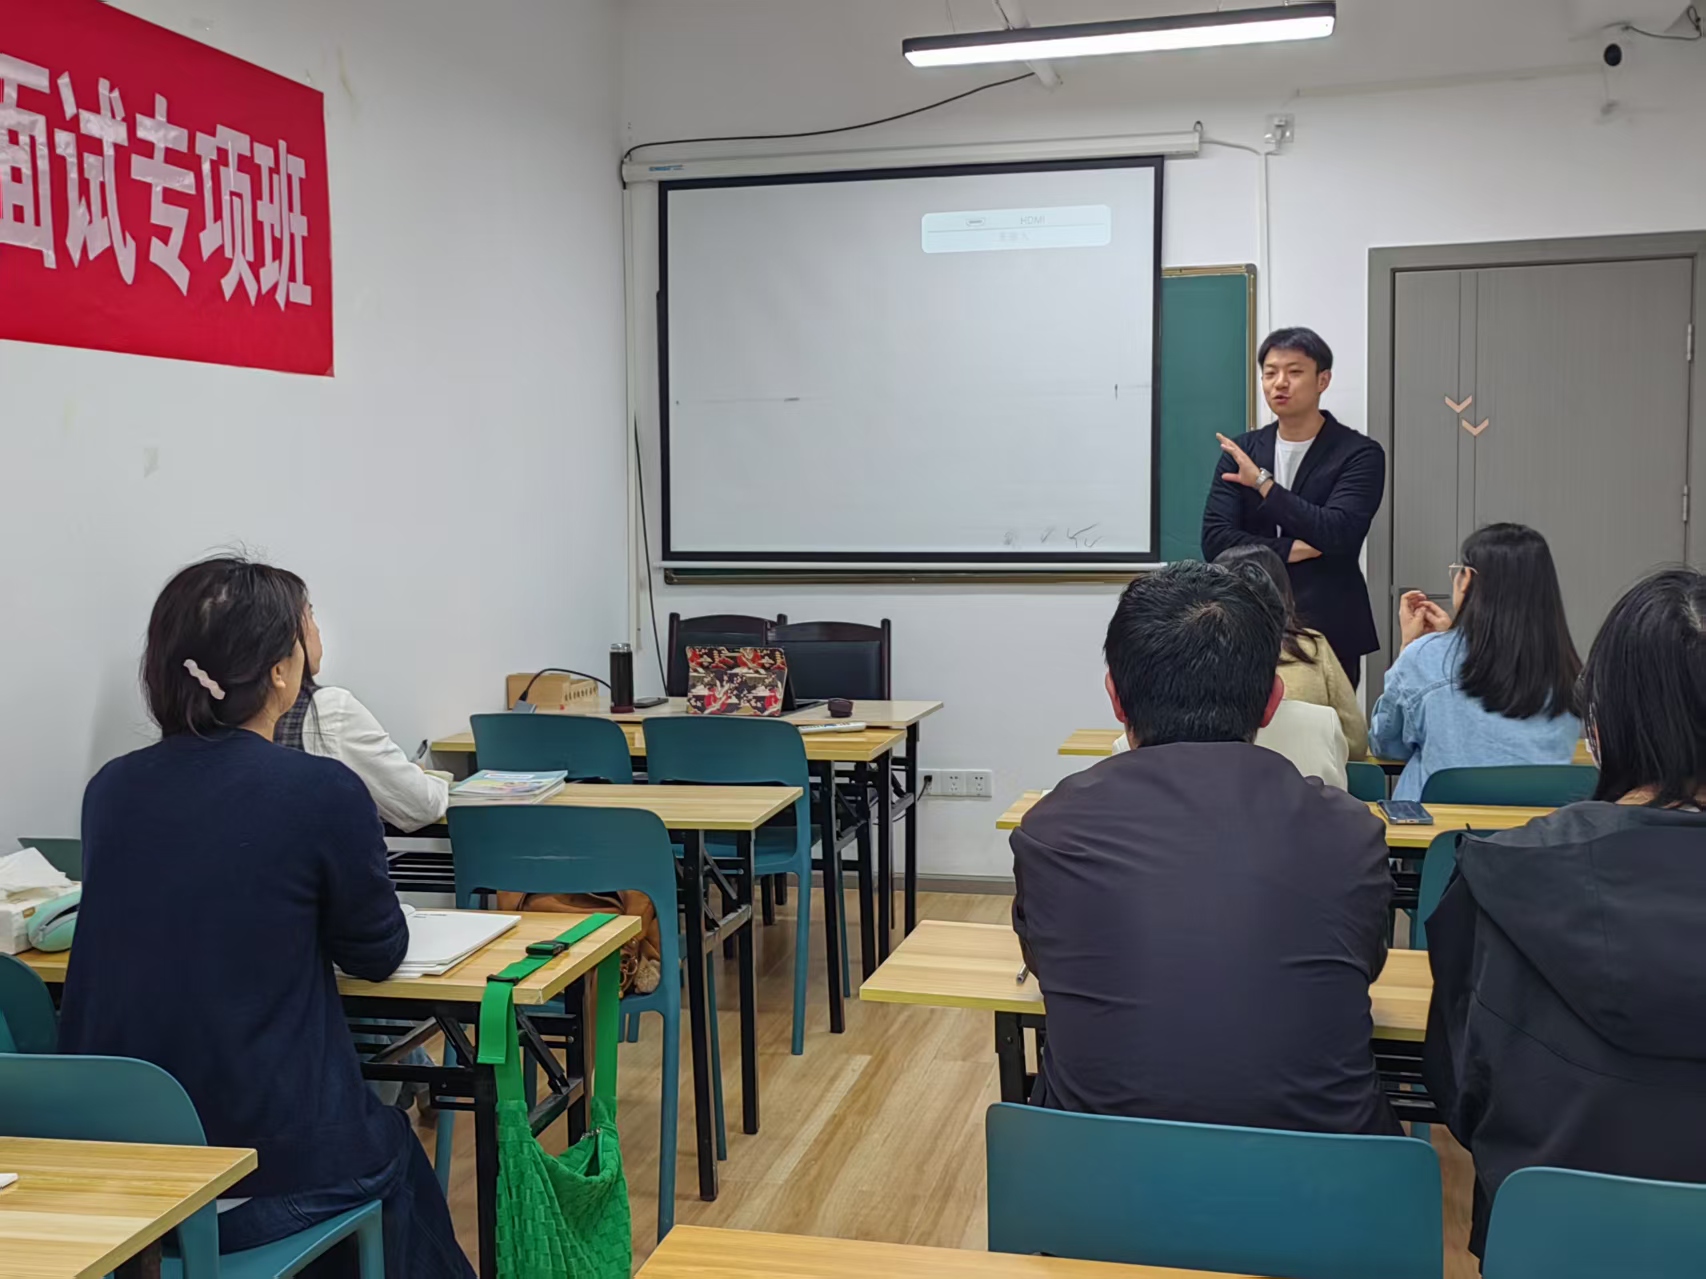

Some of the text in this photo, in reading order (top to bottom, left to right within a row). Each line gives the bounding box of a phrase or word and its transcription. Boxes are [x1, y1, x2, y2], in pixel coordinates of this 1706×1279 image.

[0, 54, 312, 312] 面试专项班
[1020, 215, 1046, 225] HDMI
